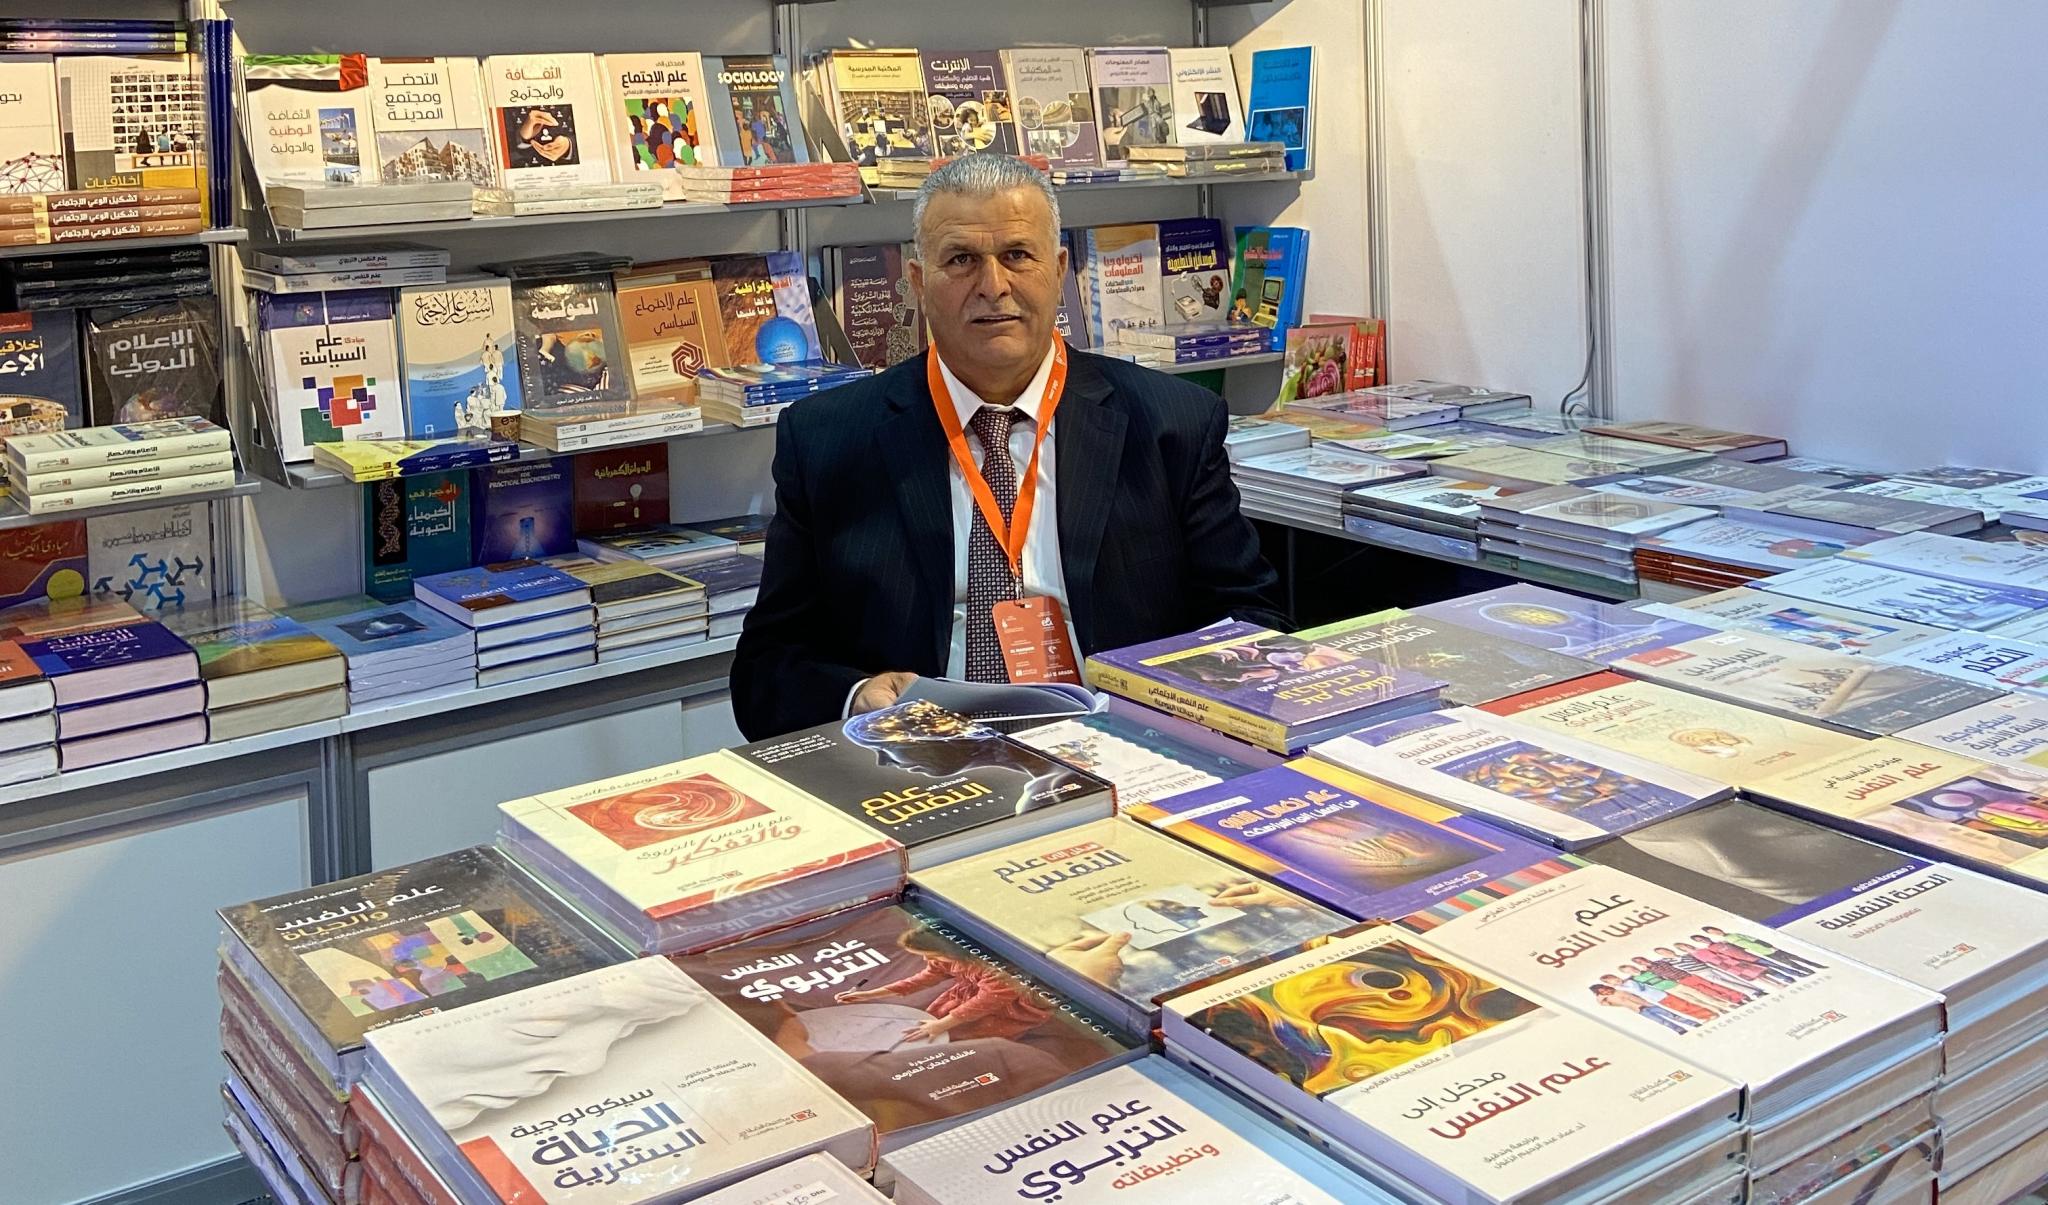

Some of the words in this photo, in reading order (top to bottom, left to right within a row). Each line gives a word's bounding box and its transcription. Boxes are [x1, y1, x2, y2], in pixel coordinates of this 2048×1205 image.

[505, 66, 562, 81] الثقافة
[667, 70, 688, 86] علم
[718, 70, 785, 85] SOCIOLOGY
[930, 57, 971, 74] الإنترنت
[383, 73, 438, 89] التحضر
[510, 85, 564, 103] والمجتمع
[385, 93, 441, 107] ومجتمع
[267, 109, 312, 122] الثقافة
[388, 108, 443, 123] المدينة
[269, 124, 313, 138] الوطنية
[270, 141, 314, 155] والدولية
[676, 292, 695, 309] علم
[653, 311, 698, 337] السياسي
[109, 328, 193, 360] الإعلام
[300, 346, 367, 369] السياسة
[110, 347, 196, 378] الدولي
[428, 483, 457, 497] الوجيز
[489, 479, 520, 489] PRACTICAL
[408, 500, 456, 522] الكيمياء
[408, 516, 457, 538] الحيوية
[1961, 647, 2034, 677] التعلم
[1176, 694, 1197, 708] النفس
[1902, 762, 1943, 780] علم
[861, 785, 930, 811] علم
[1845, 773, 1905, 802] النفس
[865, 782, 993, 826] النفس
[710, 822, 764, 843] النفس
[652, 825, 802, 875] والتفكير
[993, 858, 1048, 884] علم
[1017, 849, 1133, 895] النفس
[386, 884, 444, 907] علم
[1889, 873, 1954, 903] الصحة
[275, 899, 375, 932] النفس
[1573, 893, 1635, 927] علم
[1604, 906, 1671, 939] نفس
[1815, 895, 1902, 931] النفسية
[281, 911, 389, 942] والحياة
[813, 936, 868, 965] علم
[720, 953, 804, 982] النفس
[739, 947, 892, 1003] التربوي
[912, 911, 1005, 974] EDUCATIONAL
[1010, 970, 1116, 1039] PSYCHOLOGY
[1203, 968, 1297, 1006] INTRODUCTION
[1300, 961, 1316, 971] TO
[1317, 934, 1394, 964] PSYCHOLOGY
[414, 1004, 511, 1036] PSYCHOLOGY
[544, 983, 591, 1002] HUMAN
[598, 973, 627, 986] LIFE
[1698, 999, 1769, 1039] PSYCHOLOGY
[1439, 1069, 1506, 1104] مدخل
[1538, 1055, 1612, 1094] علم
[510, 1087, 654, 1140] سيكولوجية
[1090, 1099, 1153, 1134] علم
[1402, 1096, 1444, 1120] إلى
[1427, 1081, 1541, 1140] النفس
[531, 1101, 685, 1166] الحياة
[983, 1119, 1088, 1175] النفس
[553, 1130, 706, 1192] البشرية
[1016, 1115, 1187, 1204] التربوي
[1111, 1142, 1221, 1191] وتطبيقاته
